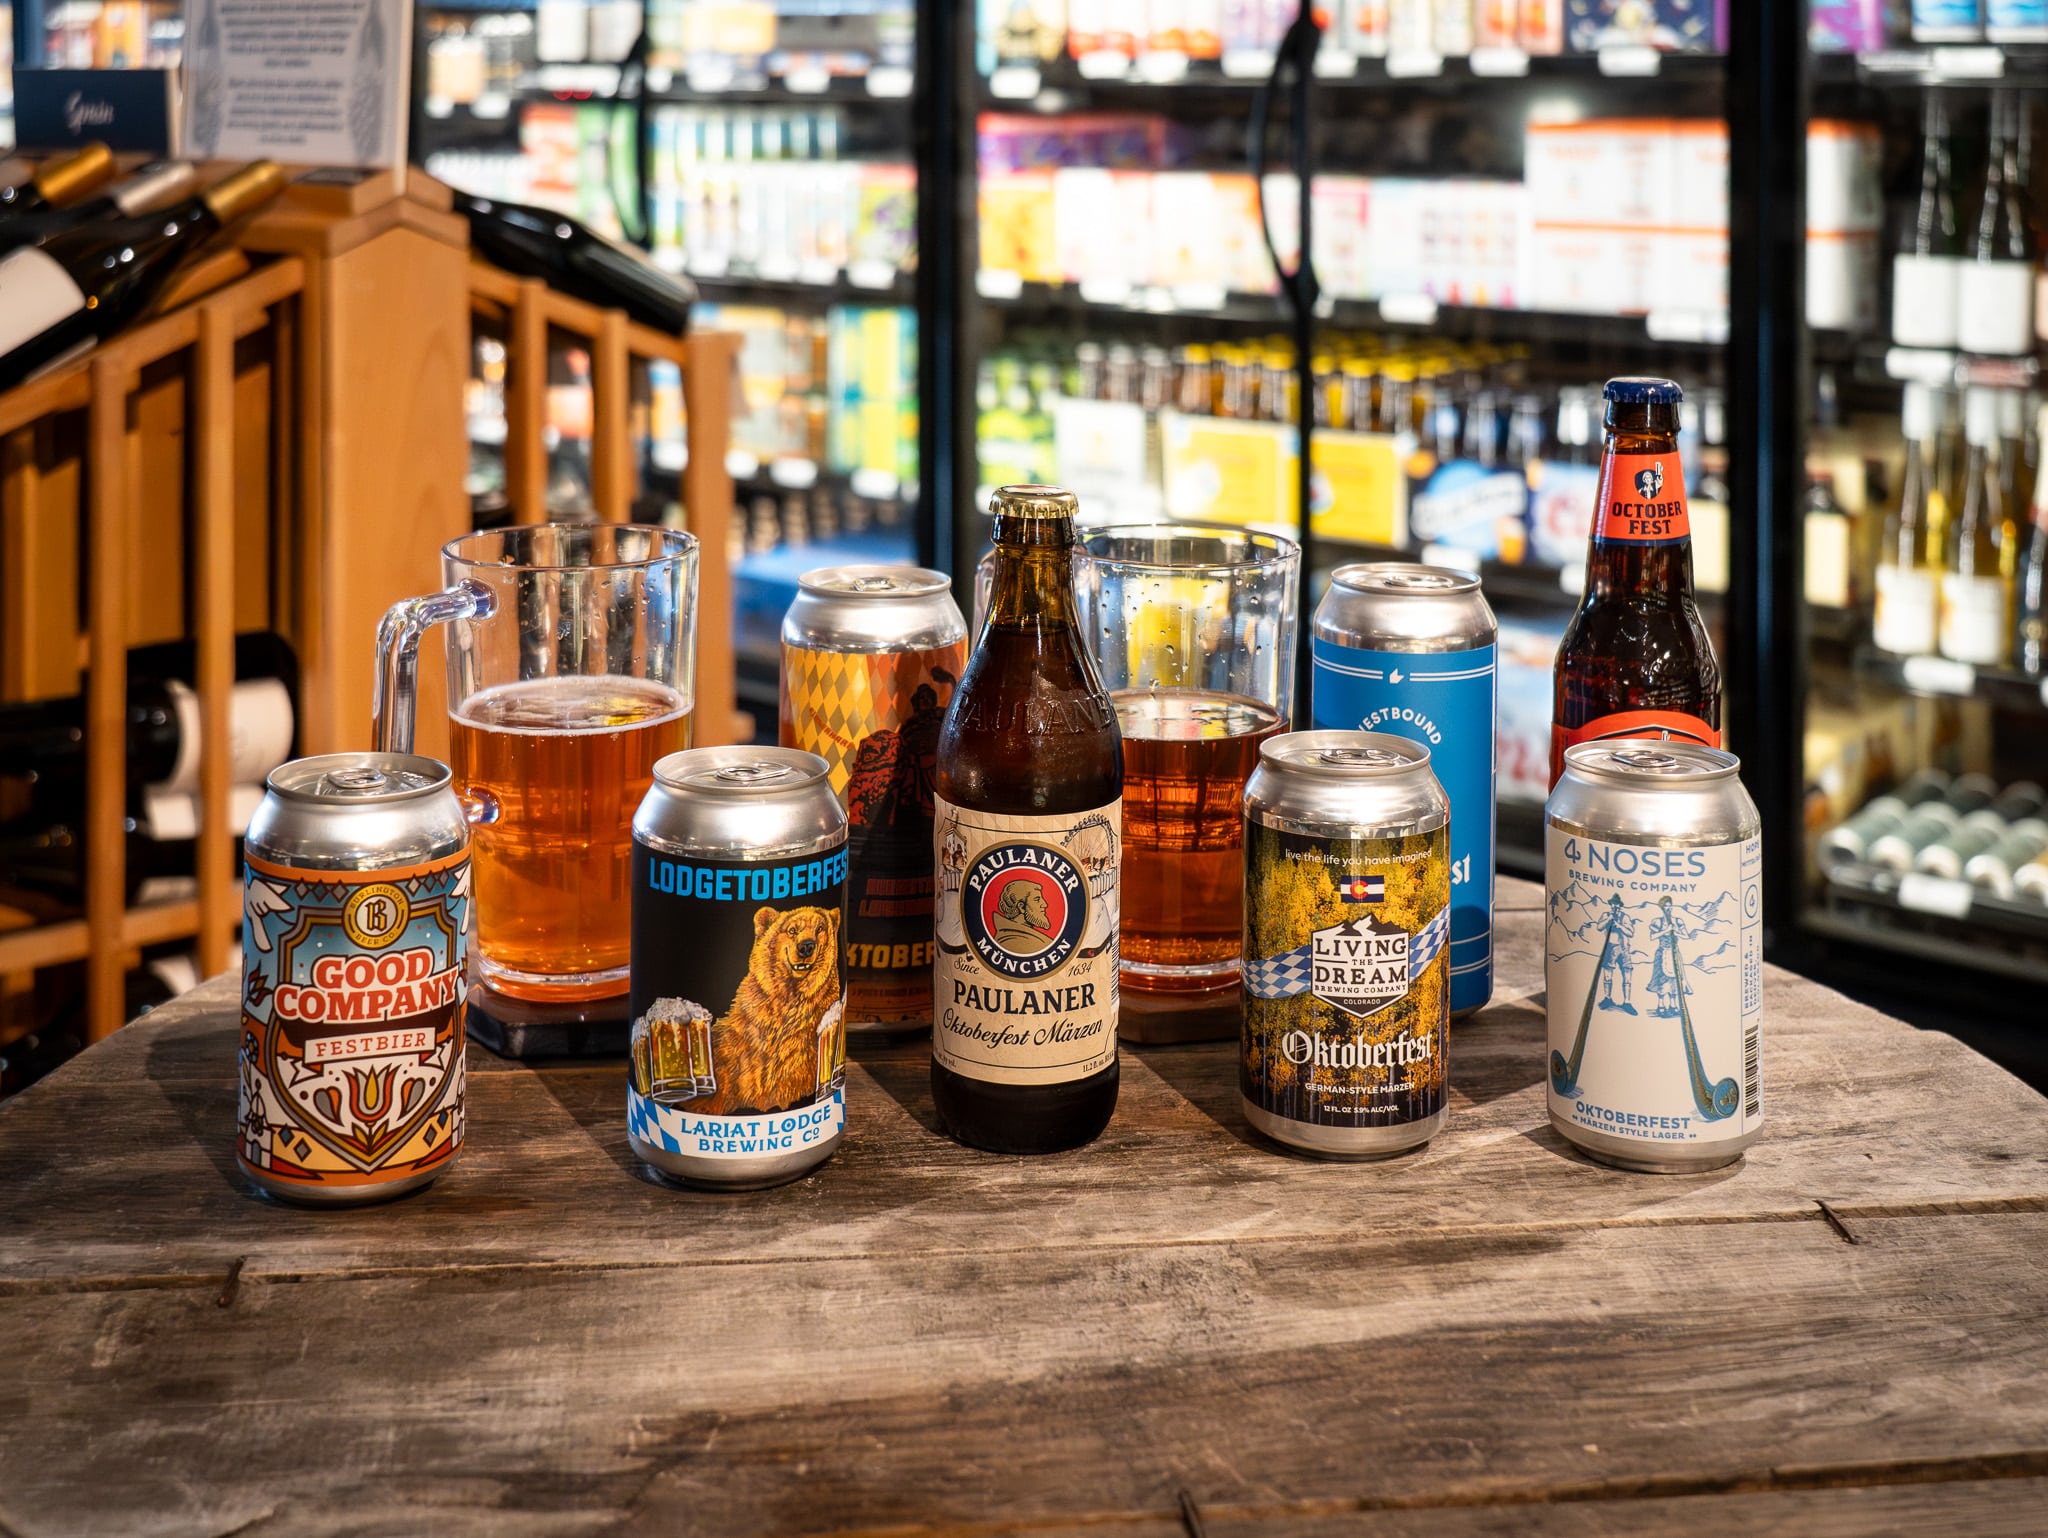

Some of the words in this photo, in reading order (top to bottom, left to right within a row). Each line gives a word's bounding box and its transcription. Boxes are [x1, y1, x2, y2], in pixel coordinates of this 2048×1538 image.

[1612, 501, 1682, 519] OCTOBER
[1629, 519, 1671, 535] FEST
[1285, 848, 1301, 861] live
[1304, 852, 1321, 863] the
[1323, 854, 1340, 865] life
[1342, 856, 1362, 867] you
[1365, 855, 1390, 865] have
[1393, 848, 1432, 866] imagined
[1564, 838, 1581, 864] 4
[1588, 843, 1705, 877] NOSES
[650, 845, 849, 901] LODGETOBERFES
[969, 848, 1080, 895] PAULANER
[1568, 869, 1625, 889] BREWING
[1630, 881, 1697, 893] COMPANY
[350, 886, 404, 908] BURLINGTON
[976, 937, 1072, 974] MÜNCHEN
[1314, 937, 1407, 956] LIVING
[315, 951, 433, 989] GOOD
[954, 957, 980, 975] Since
[1067, 961, 1093, 977] 1634
[1351, 958, 1374, 966] THE
[1314, 965, 1407, 985] DREAM
[275, 967, 459, 1022] COMPANY
[953, 978, 1096, 1015] PAULANER
[1314, 985, 1360, 994] BREWING
[1363, 984, 1407, 994] COMPANY
[943, 1007, 1030, 1049] Oktoberfest
[1033, 1018, 1103, 1046] Märzen
[315, 1032, 427, 1058] FESTBIER
[1281, 1029, 1432, 1069] Oktoberfest
[1305, 1082, 1379, 1095] GERMAN-STYLE
[681, 1118, 761, 1139] LARIAT
[768, 1104, 832, 1135] LODGE
[1576, 1100, 1691, 1129] OKTOBERFEST
[698, 1135, 793, 1154] BREWING
[1619, 1126, 1649, 1138] STYLE
[1652, 1130, 1685, 1140] LAGER
